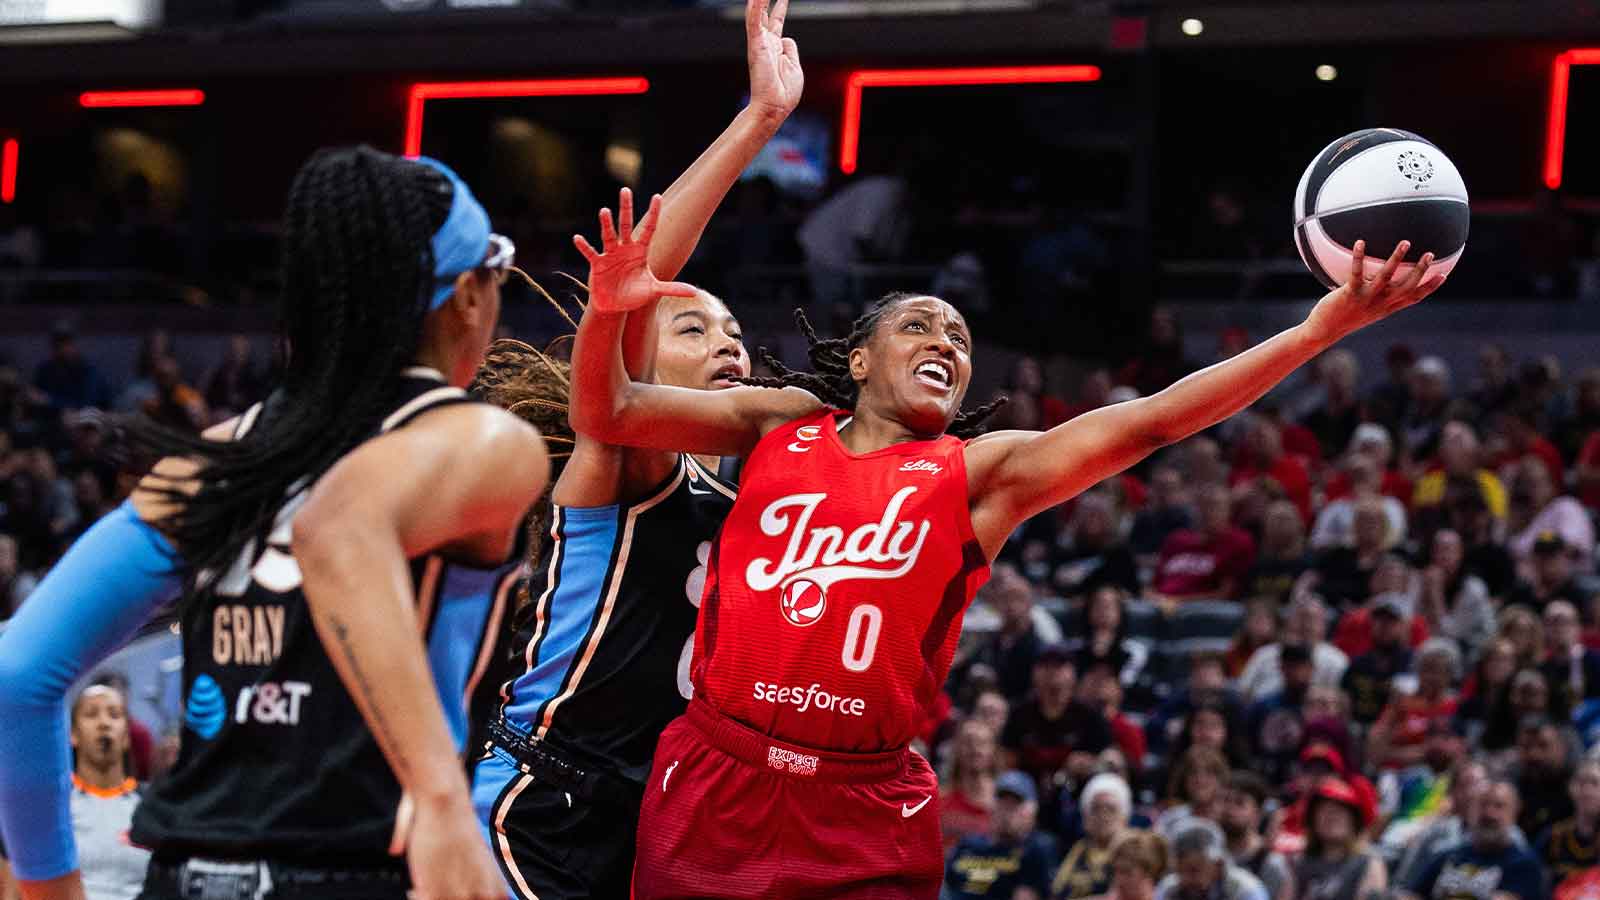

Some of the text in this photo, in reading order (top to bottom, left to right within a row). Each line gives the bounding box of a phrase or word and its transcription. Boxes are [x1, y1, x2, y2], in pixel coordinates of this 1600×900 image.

[899, 459, 943, 475] Lilly
[745, 486, 931, 592] Indy
[212, 605, 285, 665] GRAY
[841, 604, 883, 672] 0
[753, 681, 865, 716] saesforce
[768, 757, 817, 776] TO WIN
[769, 746, 819, 768] EXPECT
